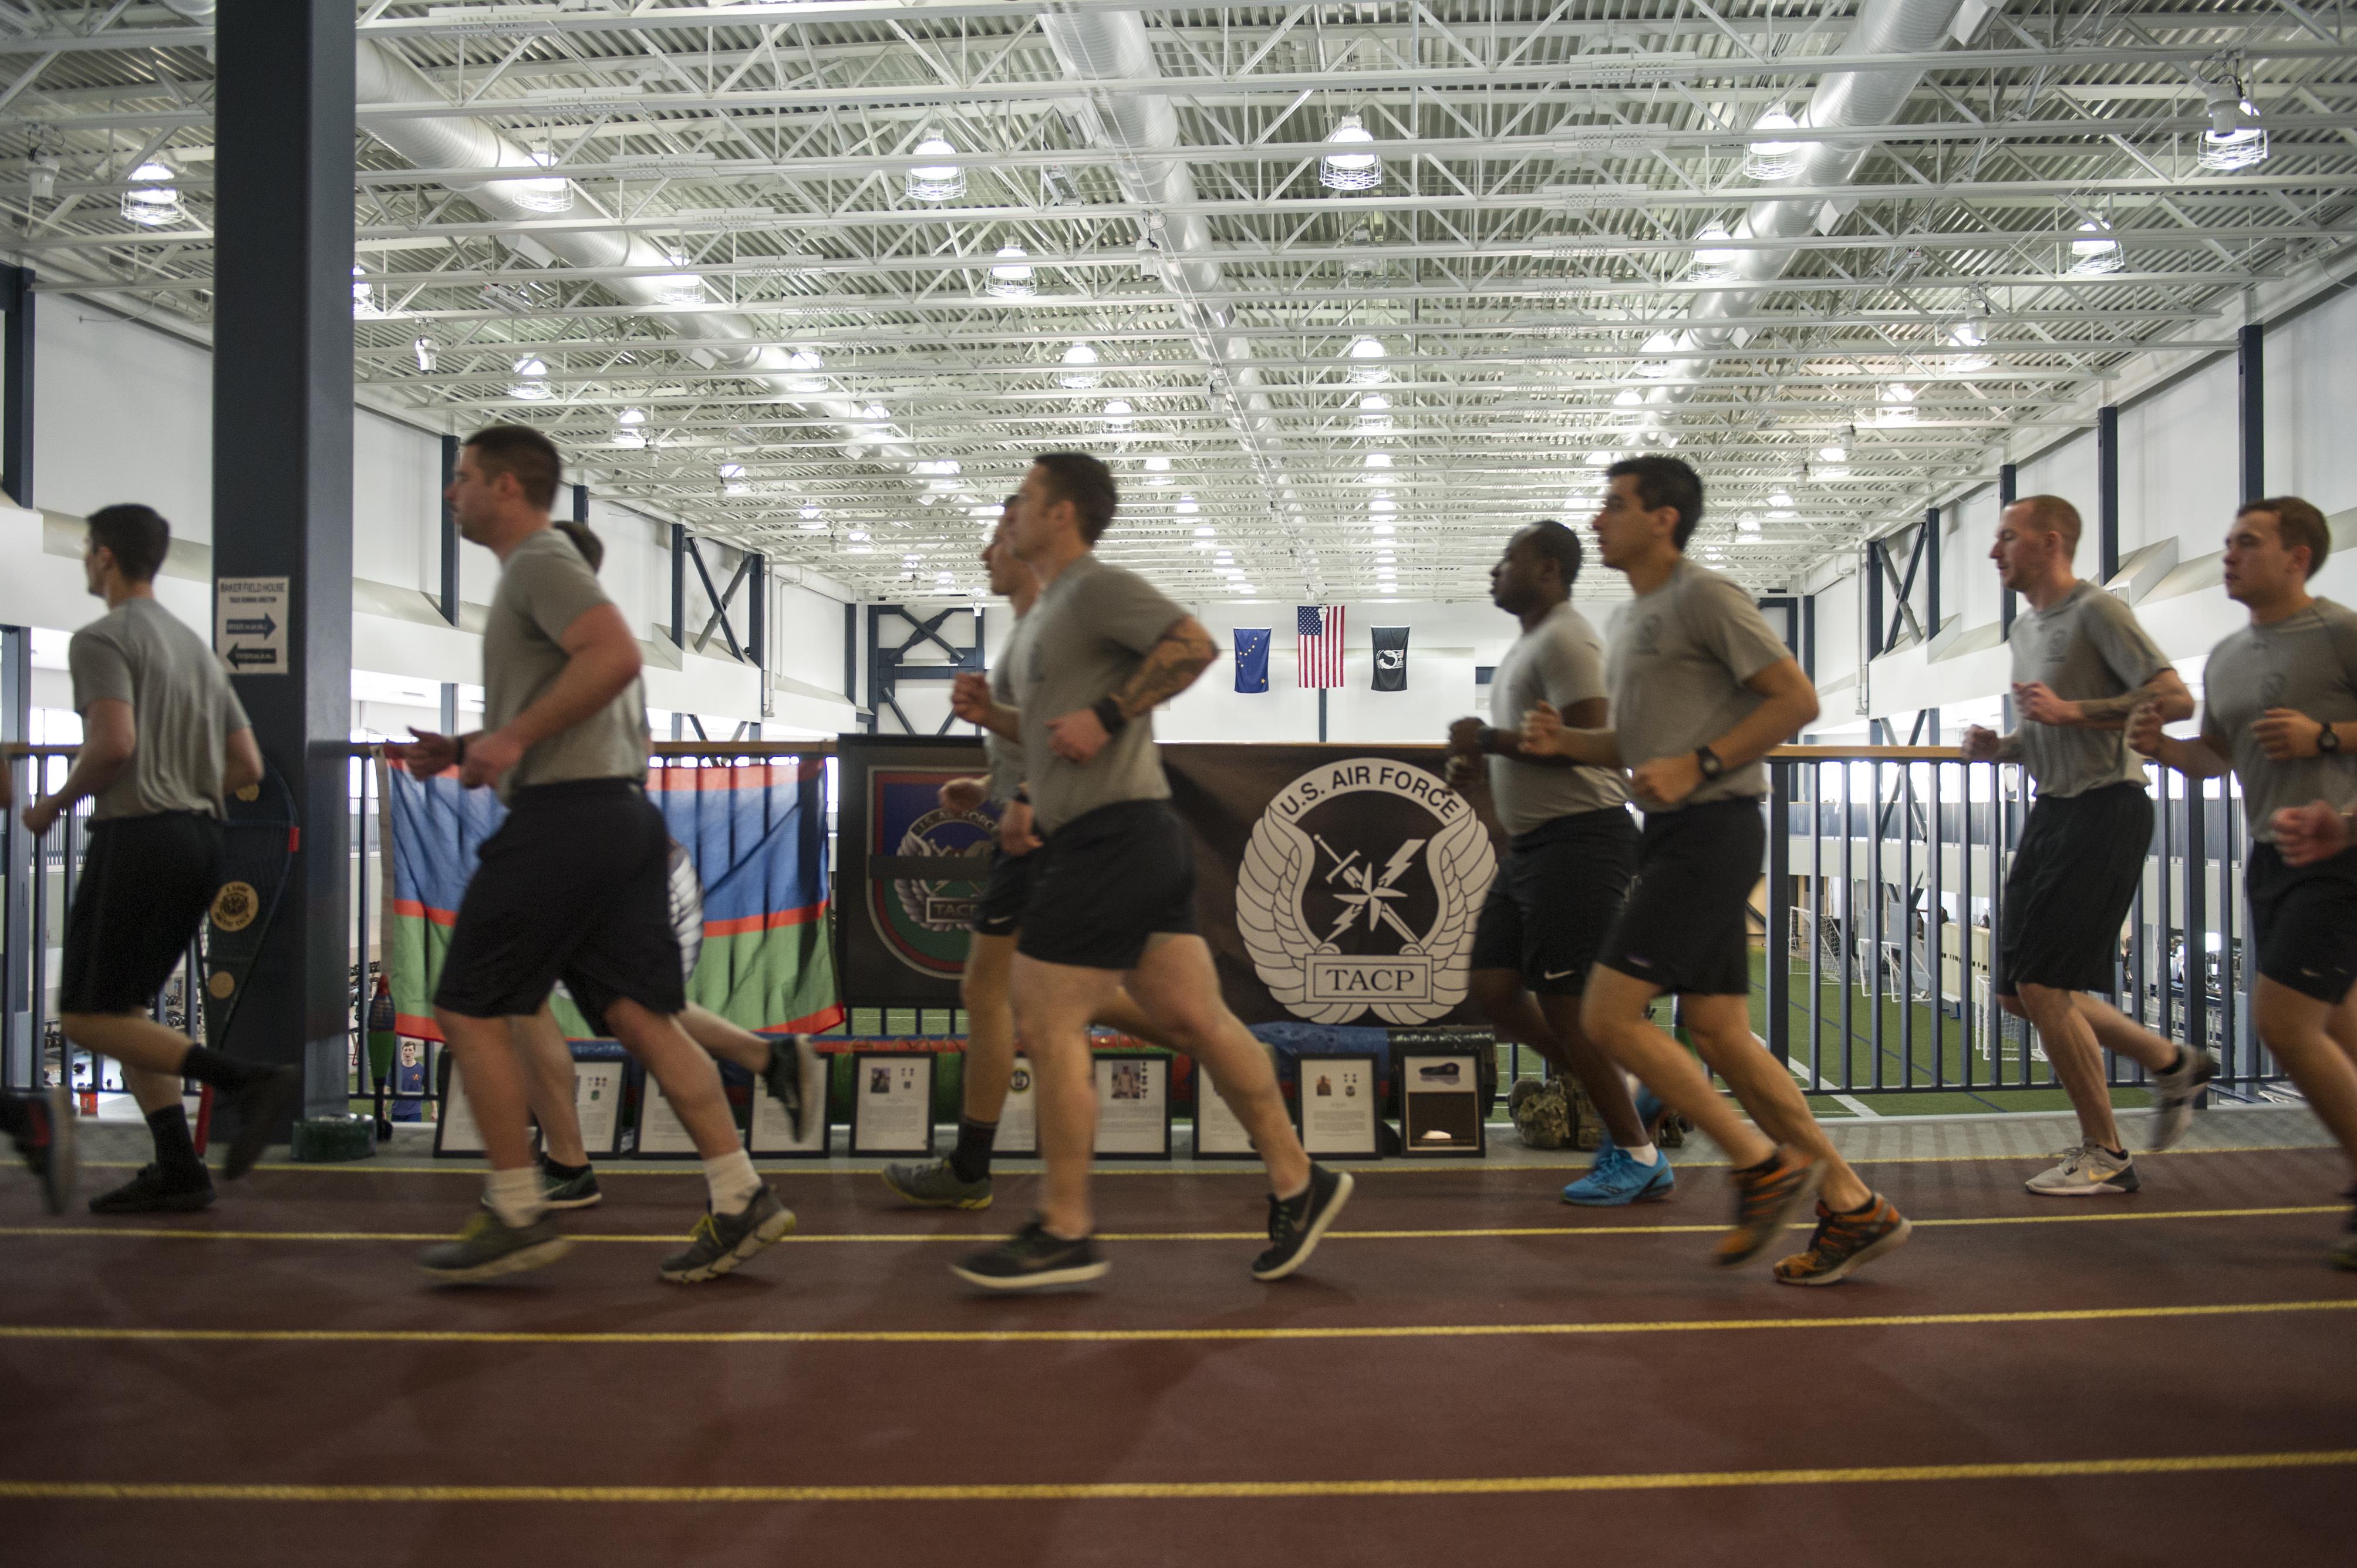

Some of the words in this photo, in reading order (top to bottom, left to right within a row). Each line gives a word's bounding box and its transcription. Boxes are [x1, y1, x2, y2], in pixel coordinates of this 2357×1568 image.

[1280, 781, 1325, 816] U.S.
[1332, 766, 1371, 790] AIR
[1379, 766, 1461, 820] FORCE
[1325, 969, 1415, 992] TACP
